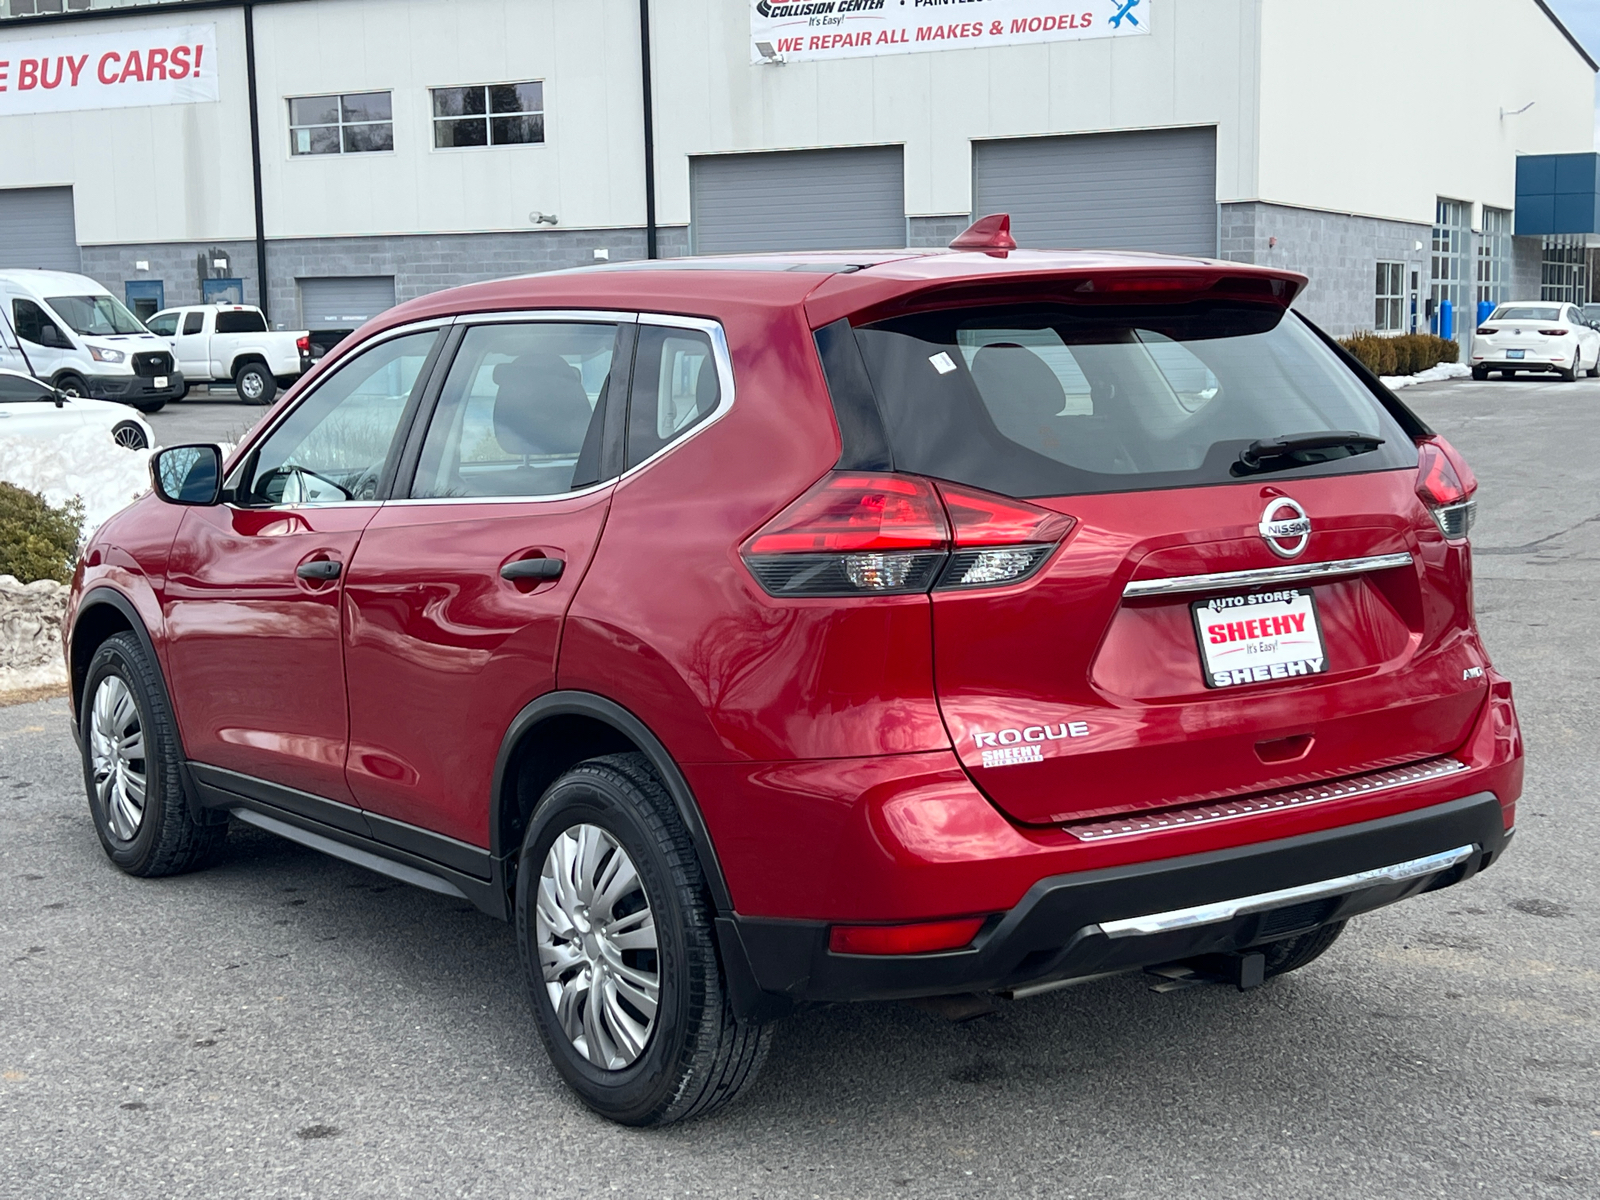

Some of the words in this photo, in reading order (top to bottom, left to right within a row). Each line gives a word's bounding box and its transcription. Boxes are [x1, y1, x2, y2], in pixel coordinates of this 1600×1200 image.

[770, 1, 835, 18] COLLISION
[837, 0, 884, 12] CENTER
[808, 16, 821, 27] It's
[822, 14, 845, 26] Easy!
[777, 37, 804, 52] WE
[808, 31, 872, 50] REPAIR
[876, 28, 909, 45] ALL
[915, 22, 983, 41] MAKES
[989, 20, 1004, 35] &
[1010, 12, 1093, 34] MODELS
[18, 54, 89, 91] BUY
[97, 44, 204, 85] CARS!
[1268, 522, 1308, 534] NISSAN
[1208, 596, 1245, 610] AUTO
[1247, 589, 1300, 605] STORES
[1207, 612, 1306, 644] SHEEHY
[1246, 642, 1258, 655] It's
[1259, 640, 1278, 654] Easy!
[1213, 658, 1324, 687] SHEEHY
[973, 721, 1090, 748] ROGUE
[981, 744, 1041, 761] SHEEHY
